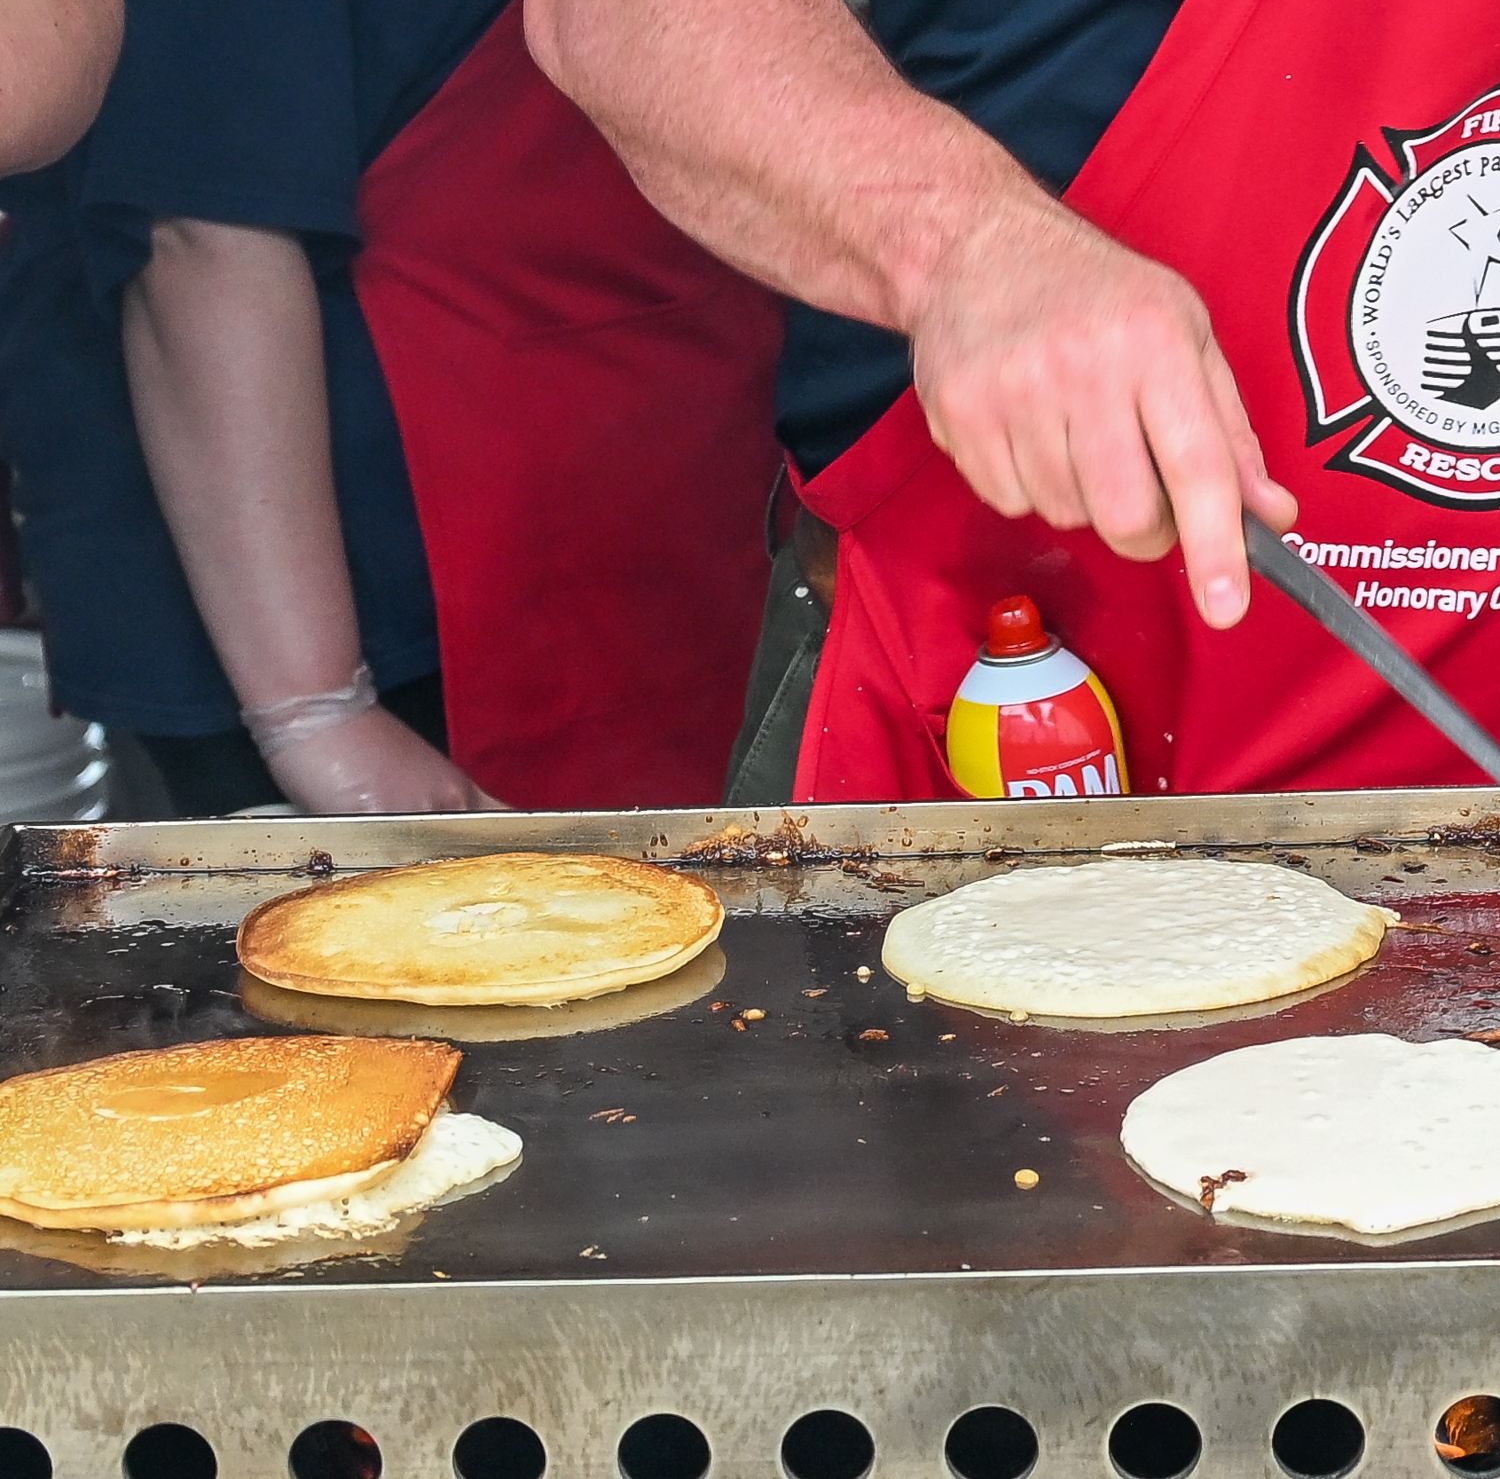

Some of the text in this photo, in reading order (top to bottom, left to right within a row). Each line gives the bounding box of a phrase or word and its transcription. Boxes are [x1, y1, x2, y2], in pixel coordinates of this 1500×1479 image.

[1366, 340, 1439, 425] SPONSORED
[1442, 418, 1467, 434] BY
[1354, 581, 1488, 620] Honorary
